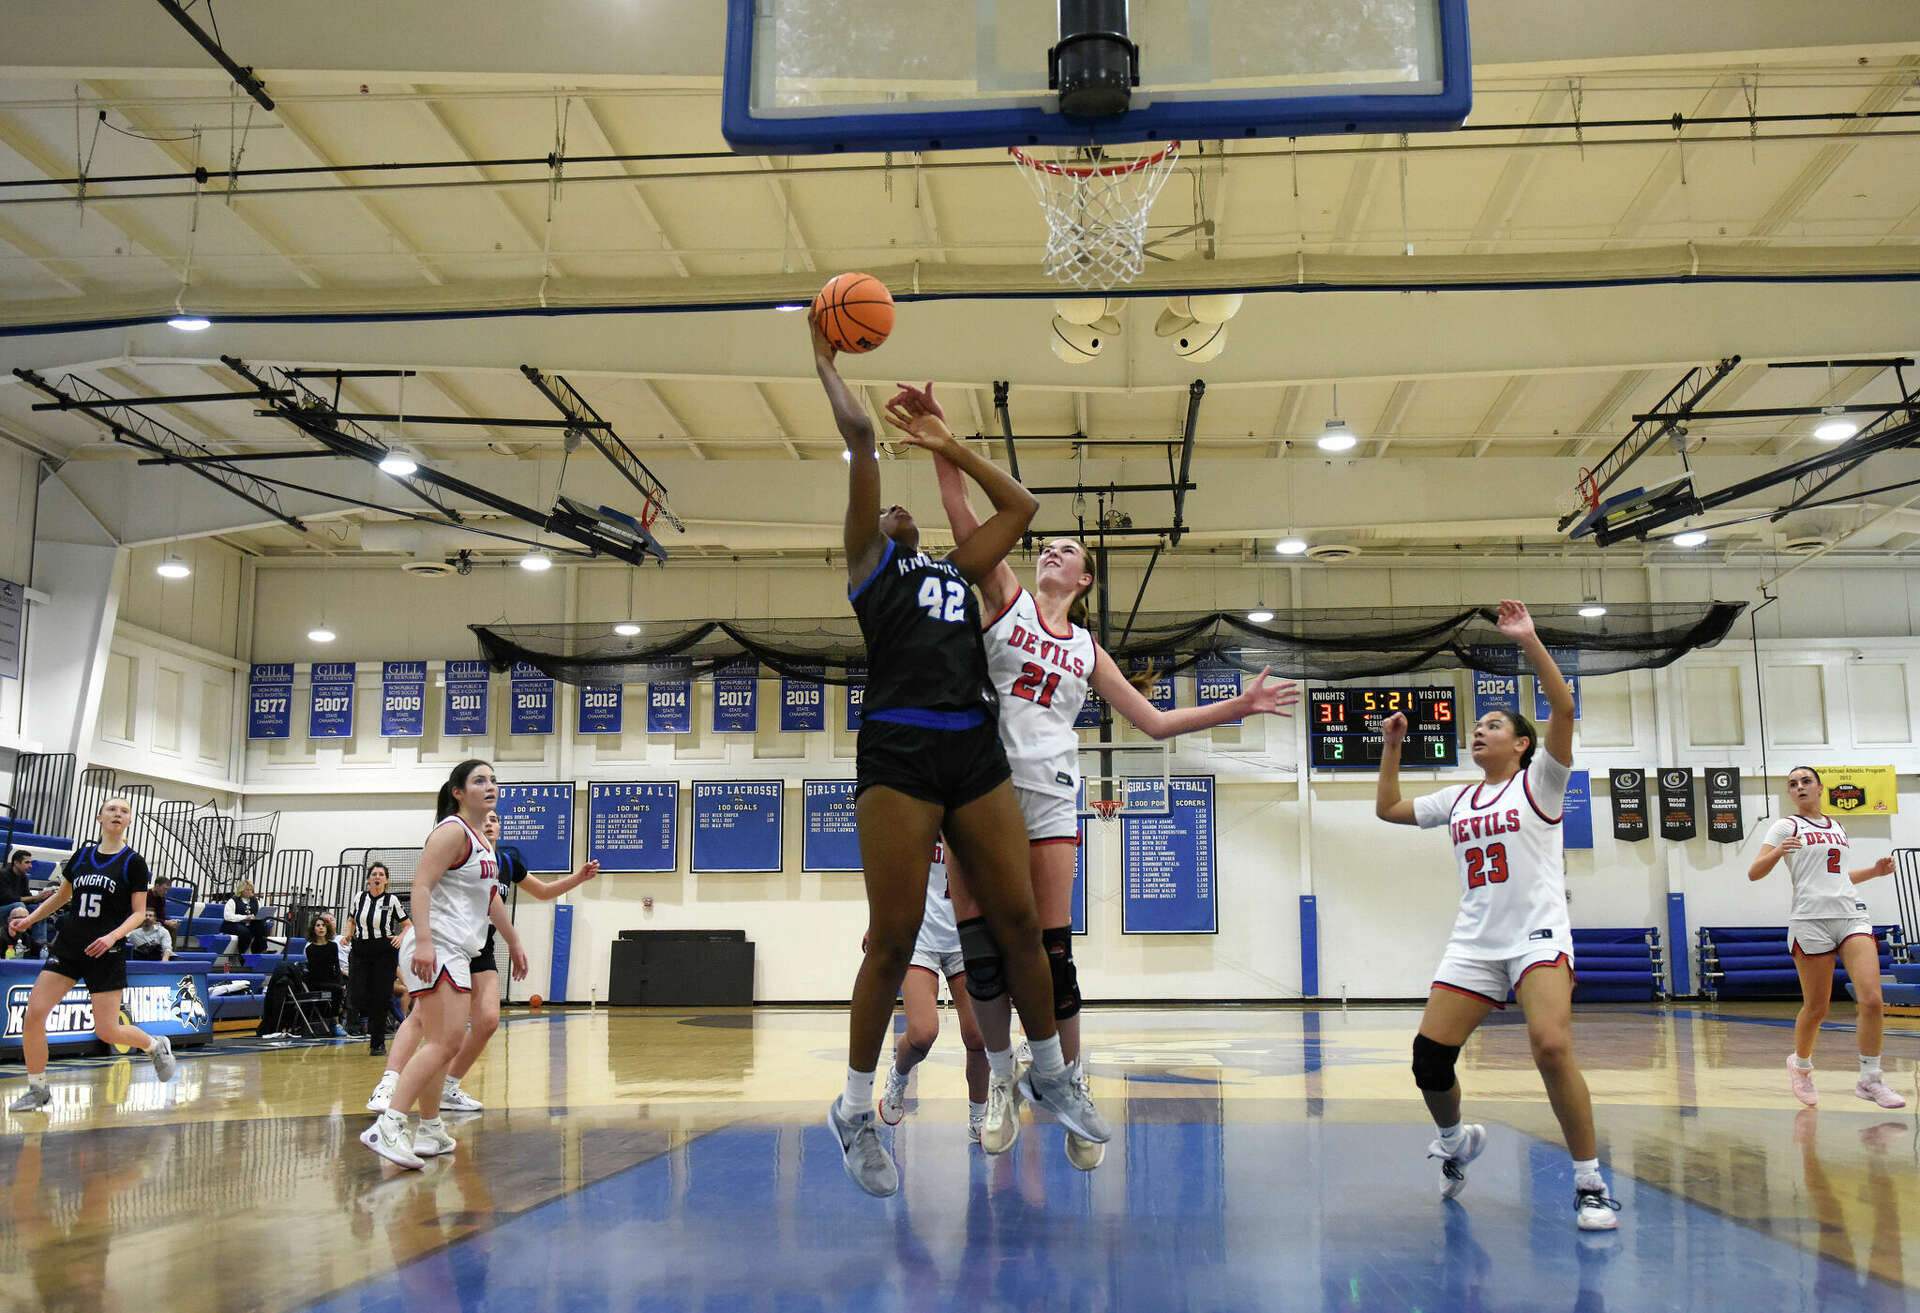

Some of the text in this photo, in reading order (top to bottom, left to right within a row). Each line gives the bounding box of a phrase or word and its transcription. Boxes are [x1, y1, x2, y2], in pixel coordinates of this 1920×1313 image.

[918, 576, 967, 622] 42
[1008, 625, 1084, 678] DEVILS
[255, 665, 289, 676] GILL
[317, 664, 351, 676] GILL
[388, 663, 421, 675] GILL
[451, 662, 484, 673] GILL
[1011, 661, 1062, 709] 21
[1150, 685, 1172, 700] 23
[1200, 684, 1238, 700] 2023
[1477, 679, 1515, 695] 2024
[517, 694, 547, 708] 2011
[584, 693, 618, 708] 2012
[652, 692, 686, 707] 2014
[719, 692, 752, 706] 2017
[786, 690, 820, 705] 2019
[1312, 692, 1345, 701] KNIGHTS
[1364, 692, 1413, 711] 5:21
[1419, 690, 1452, 699] VISITOR
[254, 699, 286, 713] 1977
[314, 698, 349, 712] 2007
[385, 697, 421, 711] 2009
[451, 695, 481, 710] 2011
[1320, 703, 1344, 723] 31
[1434, 702, 1451, 721] 15
[1334, 743, 1344, 759] 2
[1434, 743, 1445, 758] 0
[500, 787, 570, 799] OFTBALL
[593, 786, 674, 799] BASEBALL
[697, 785, 778, 797] BOYS LACROSSE
[807, 784, 836, 796] GIRLS
[1128, 781, 1208, 793] GIRLS BAKETBALL
[1175, 799, 1206, 807] SCORERS
[1837, 798, 1858, 809] CUP
[1451, 809, 1520, 846] DEVILS
[1804, 831, 1849, 847] DEVIL
[1465, 842, 1509, 889] 23
[1827, 848, 1841, 873] 2
[73, 874, 117, 893] KNIGHTS
[78, 893, 102, 918] 15
[8, 1003, 96, 1034] KGHTS
